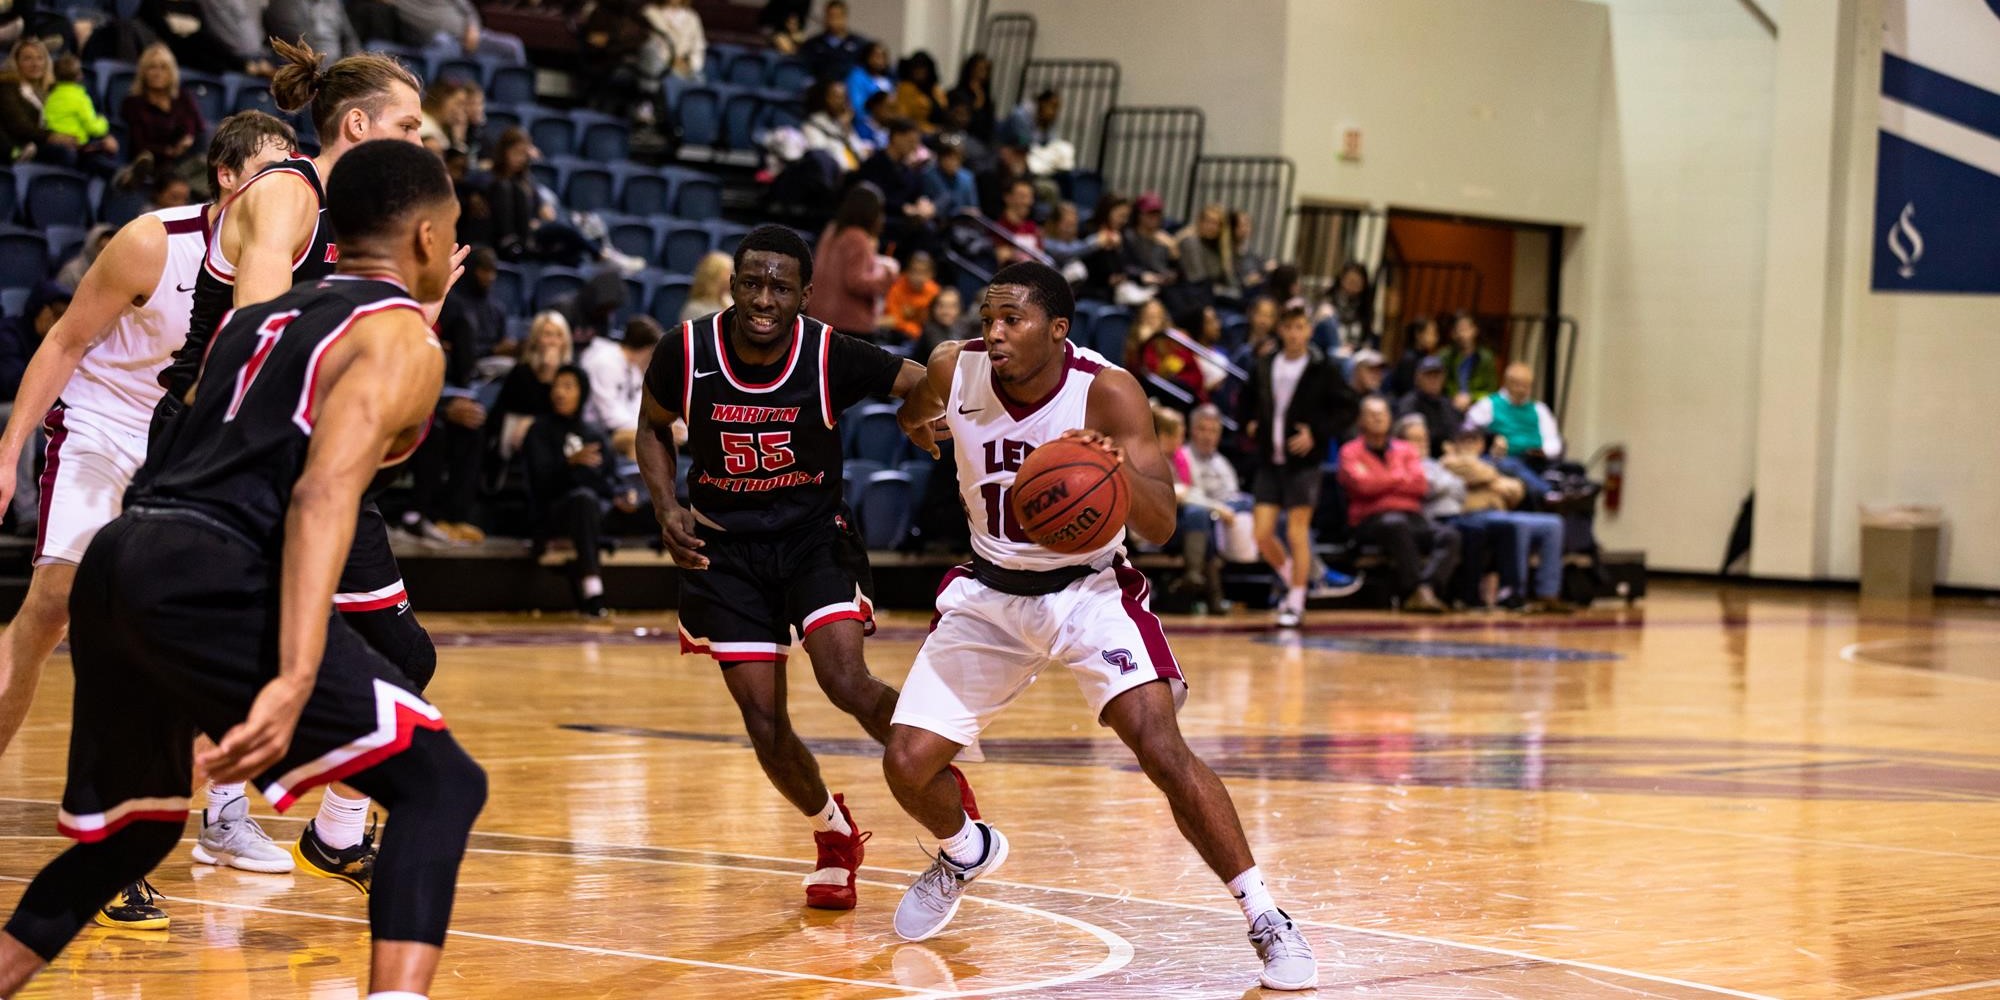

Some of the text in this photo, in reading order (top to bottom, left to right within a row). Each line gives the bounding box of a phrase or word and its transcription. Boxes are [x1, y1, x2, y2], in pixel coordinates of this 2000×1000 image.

[223, 309, 302, 423] 1
[711, 403, 800, 424] MARTIN
[720, 431, 796, 475] 55
[1021, 480, 1070, 520] NCAA
